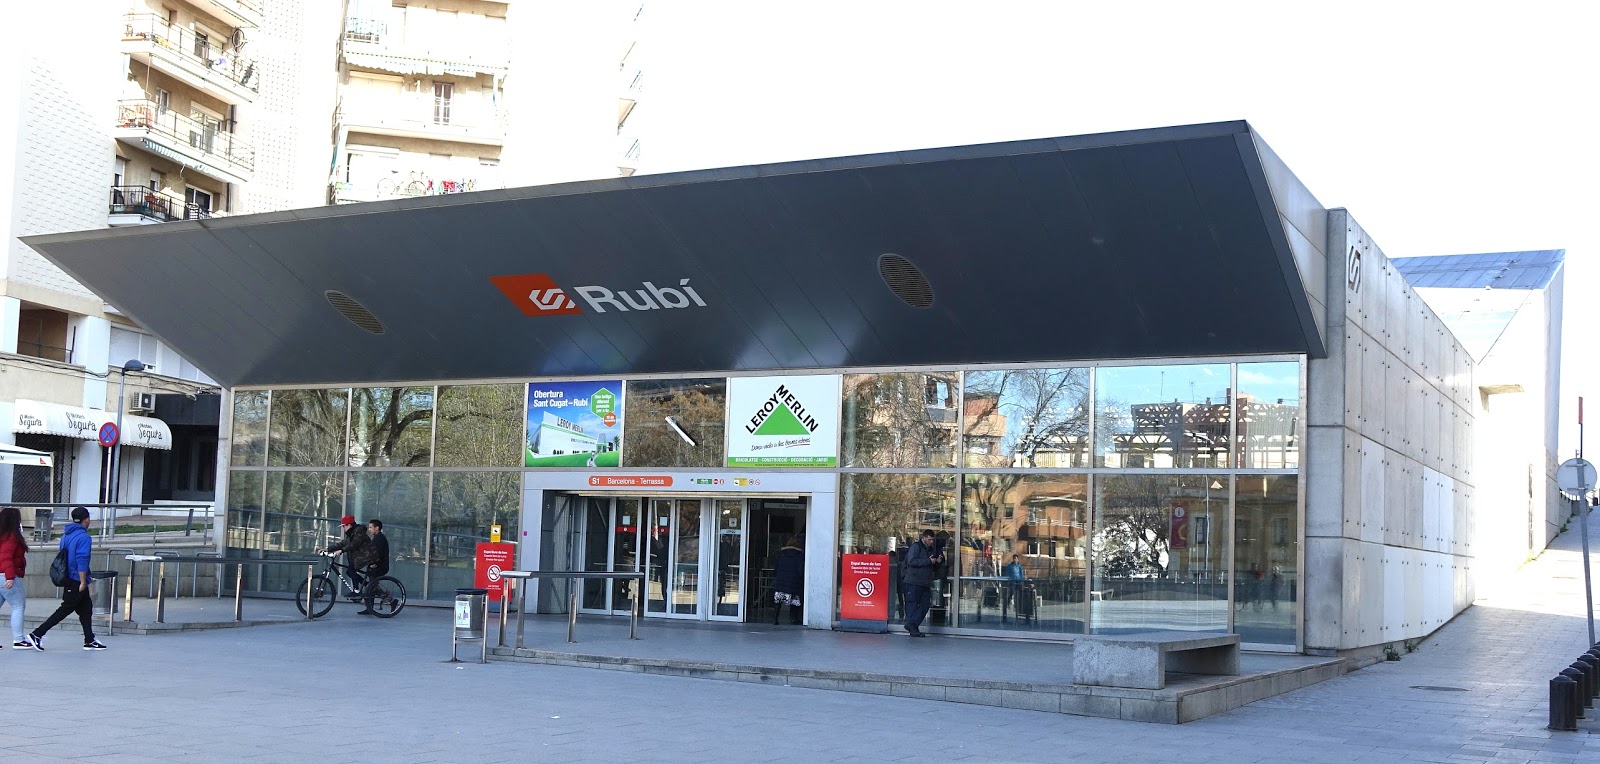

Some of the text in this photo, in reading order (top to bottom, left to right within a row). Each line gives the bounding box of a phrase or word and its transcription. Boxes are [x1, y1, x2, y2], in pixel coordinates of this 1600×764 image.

[573, 278, 708, 313] Rubí
[533, 390, 564, 398] Obertura
[533, 399, 549, 407] Sant
[745, 393, 780, 434] LEROY
[775, 384, 819, 433] MERLIN
[19, 414, 42, 430] Segura
[65, 411, 97, 436] Segura
[556, 416, 572, 430] LEROY
[137, 422, 163, 444] Segura
[592, 477, 600, 485] S1
[607, 477, 635, 485] Barcelona
[639, 477, 665, 485] Terrassa
